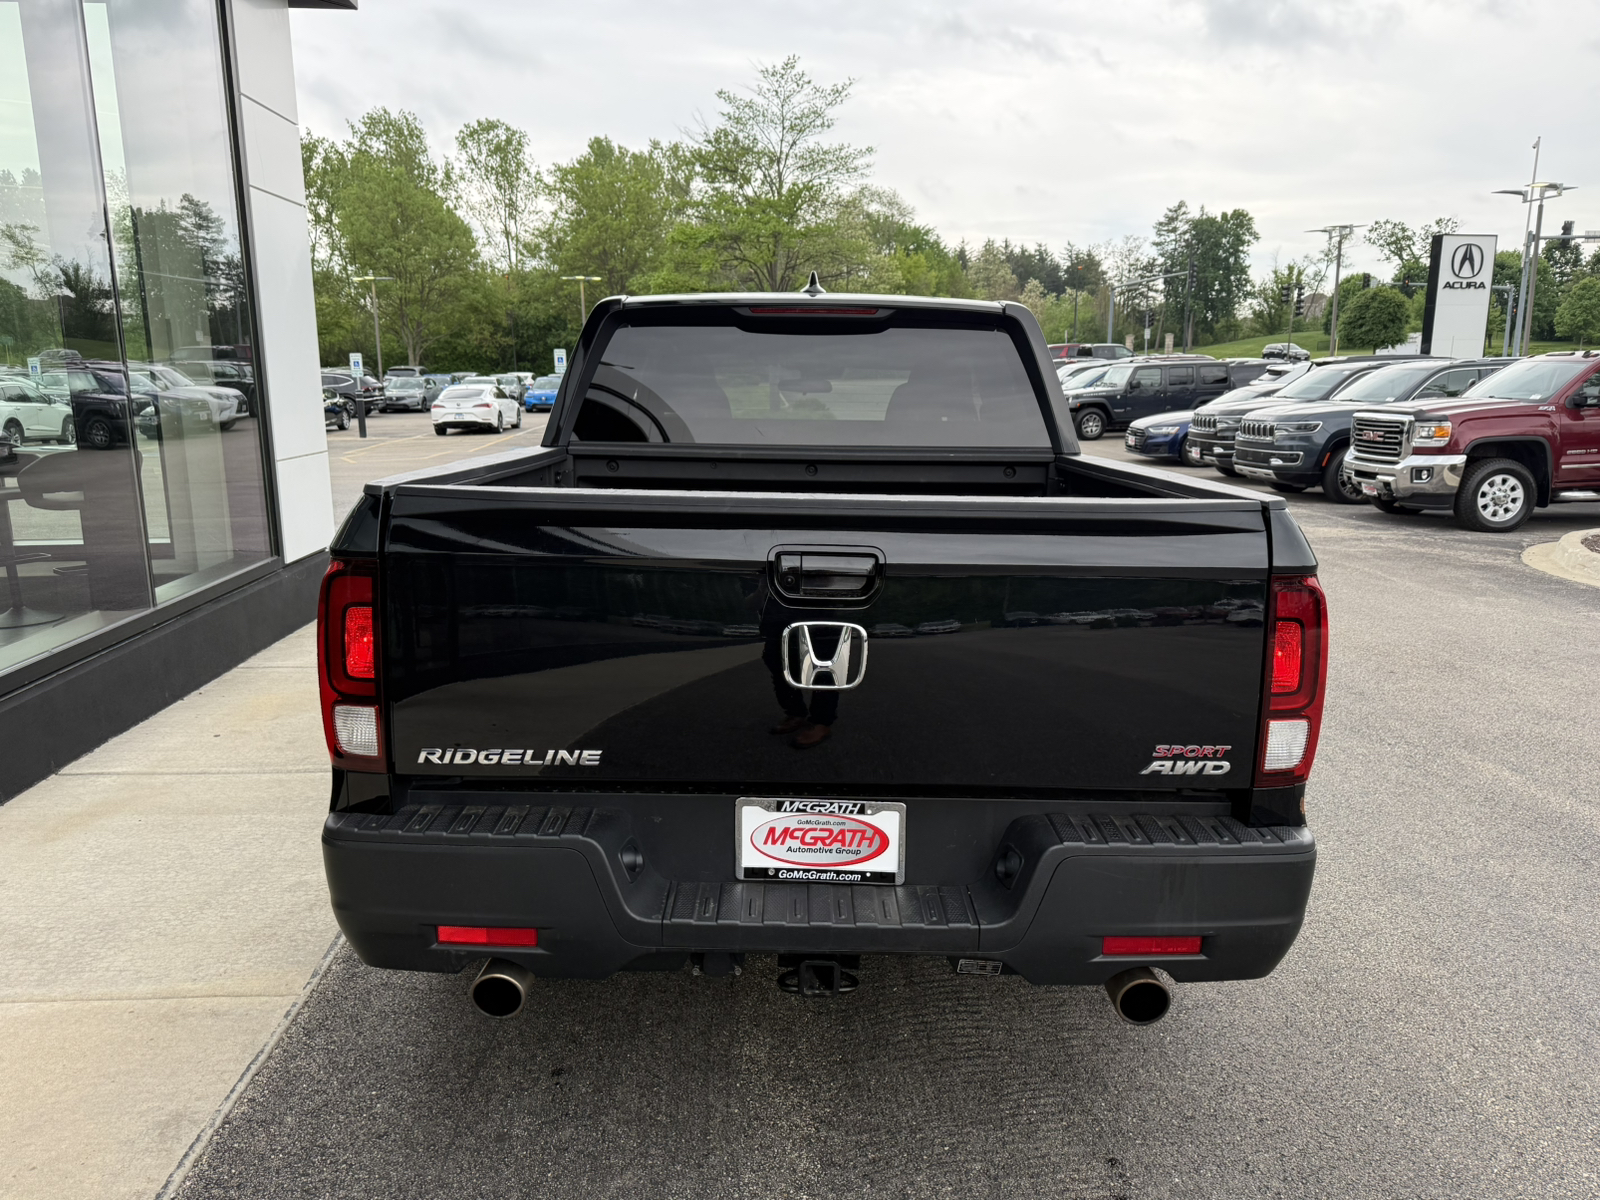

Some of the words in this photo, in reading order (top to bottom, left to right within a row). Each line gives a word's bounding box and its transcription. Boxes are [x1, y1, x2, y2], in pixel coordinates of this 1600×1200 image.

[1442, 281, 1486, 290] ACURA
[417, 748, 603, 766] RIDGELINE
[1152, 744, 1232, 758] SPORT
[1139, 760, 1231, 775] AWD
[797, 819, 846, 827] GoMcGrath.com
[786, 846, 833, 854] Automotive
[835, 847, 862, 856] Group
[778, 869, 861, 881] GoMcGrath.com
